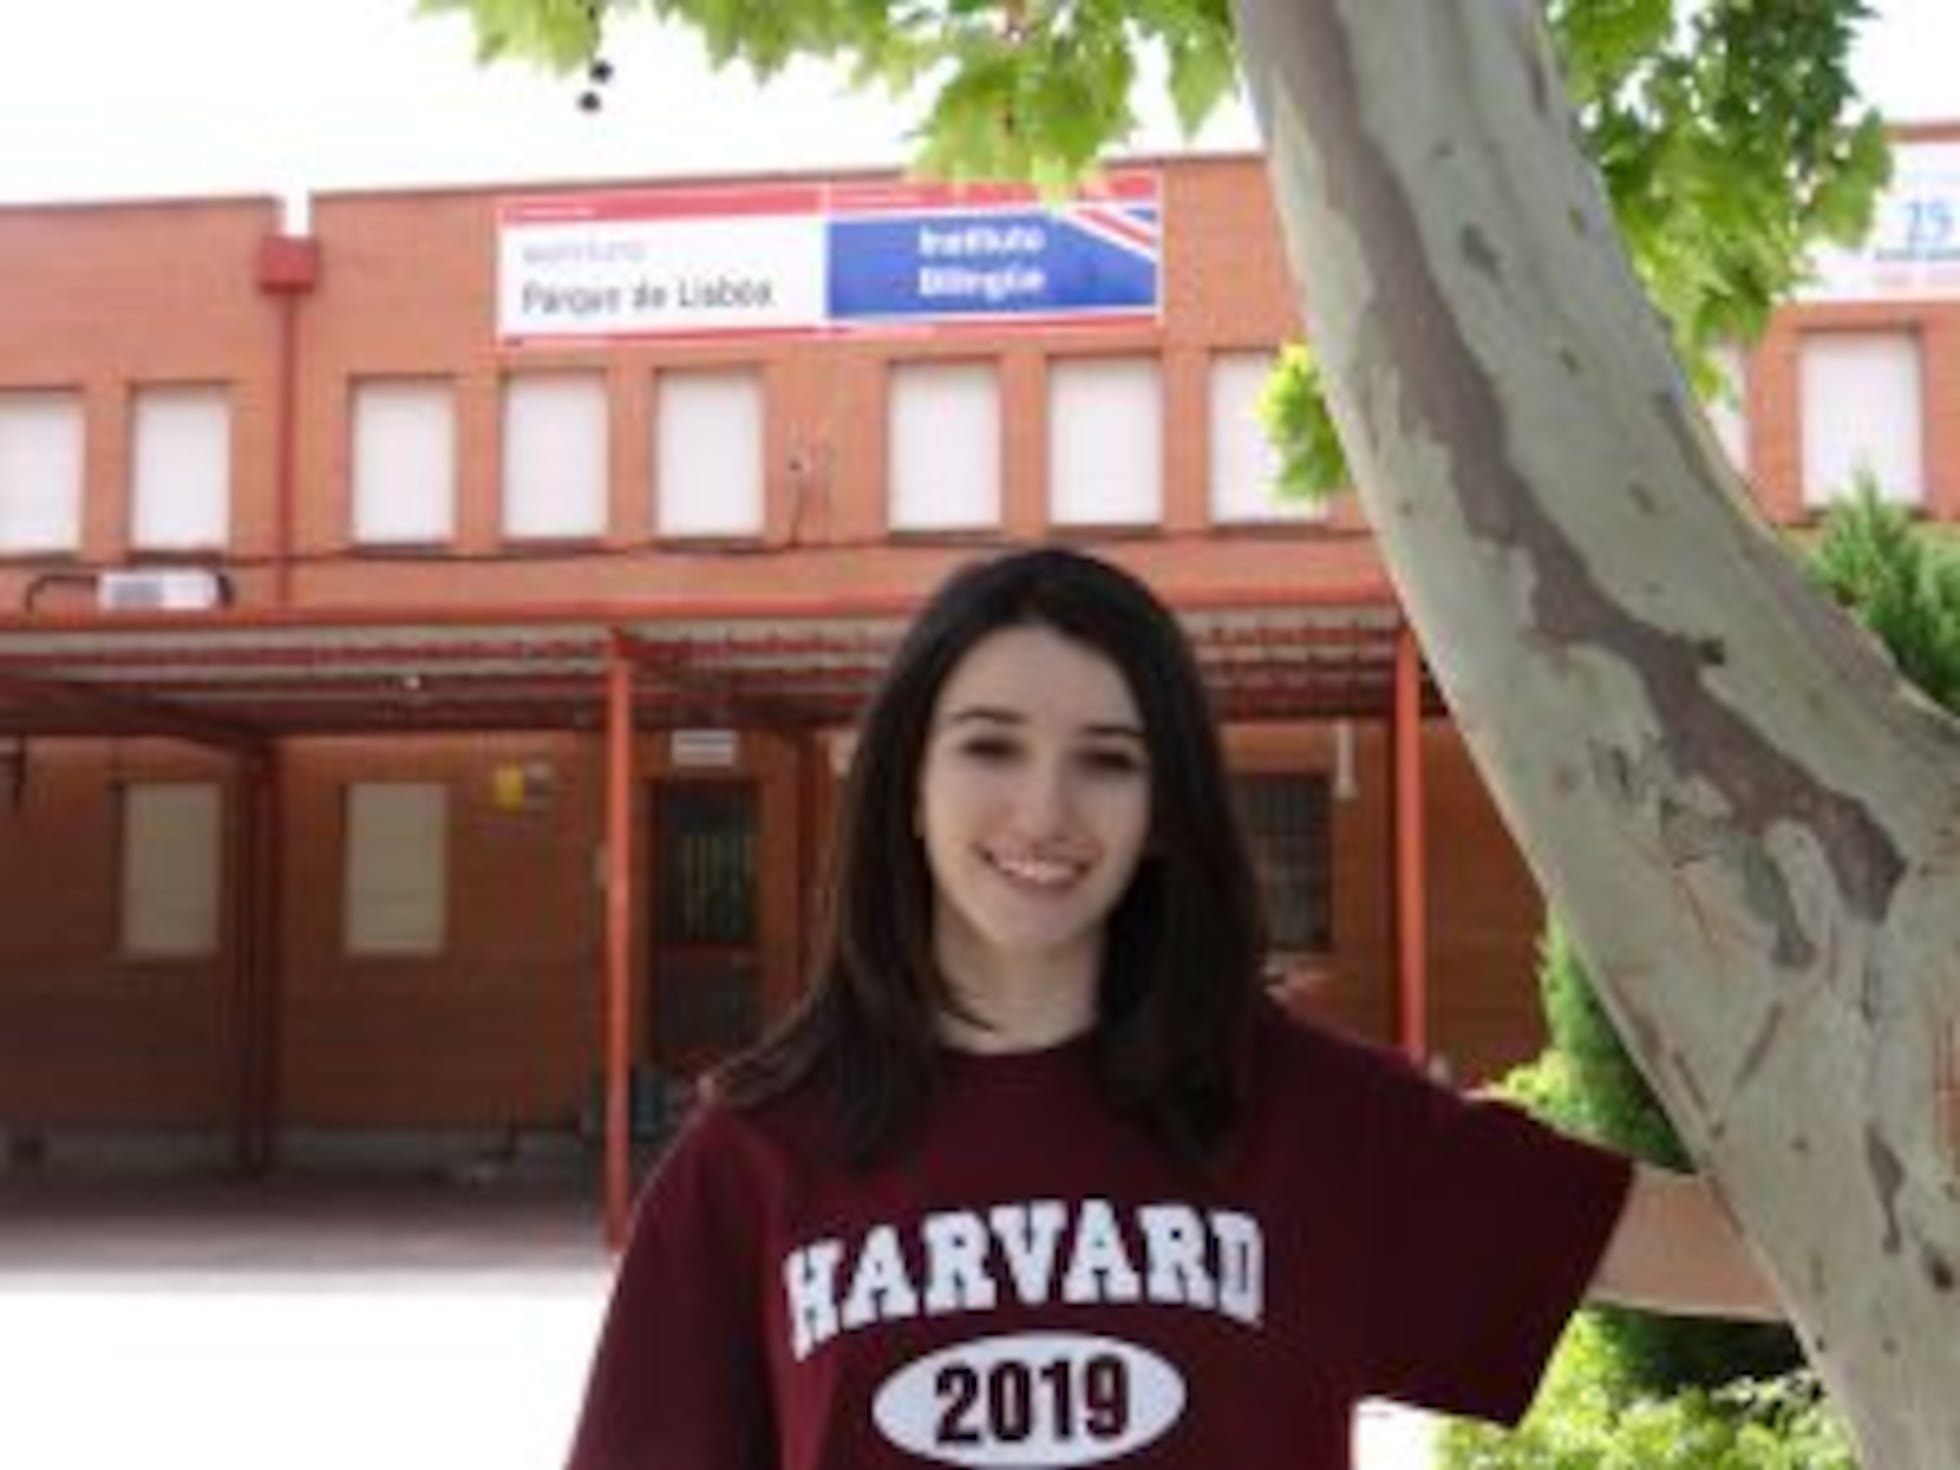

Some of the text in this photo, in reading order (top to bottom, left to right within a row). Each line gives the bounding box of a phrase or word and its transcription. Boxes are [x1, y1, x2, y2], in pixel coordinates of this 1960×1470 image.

[521, 273, 775, 319] Parque de Lisboa
[785, 1199, 1265, 1360] HARVARD
[934, 1356, 1131, 1444] 2019
